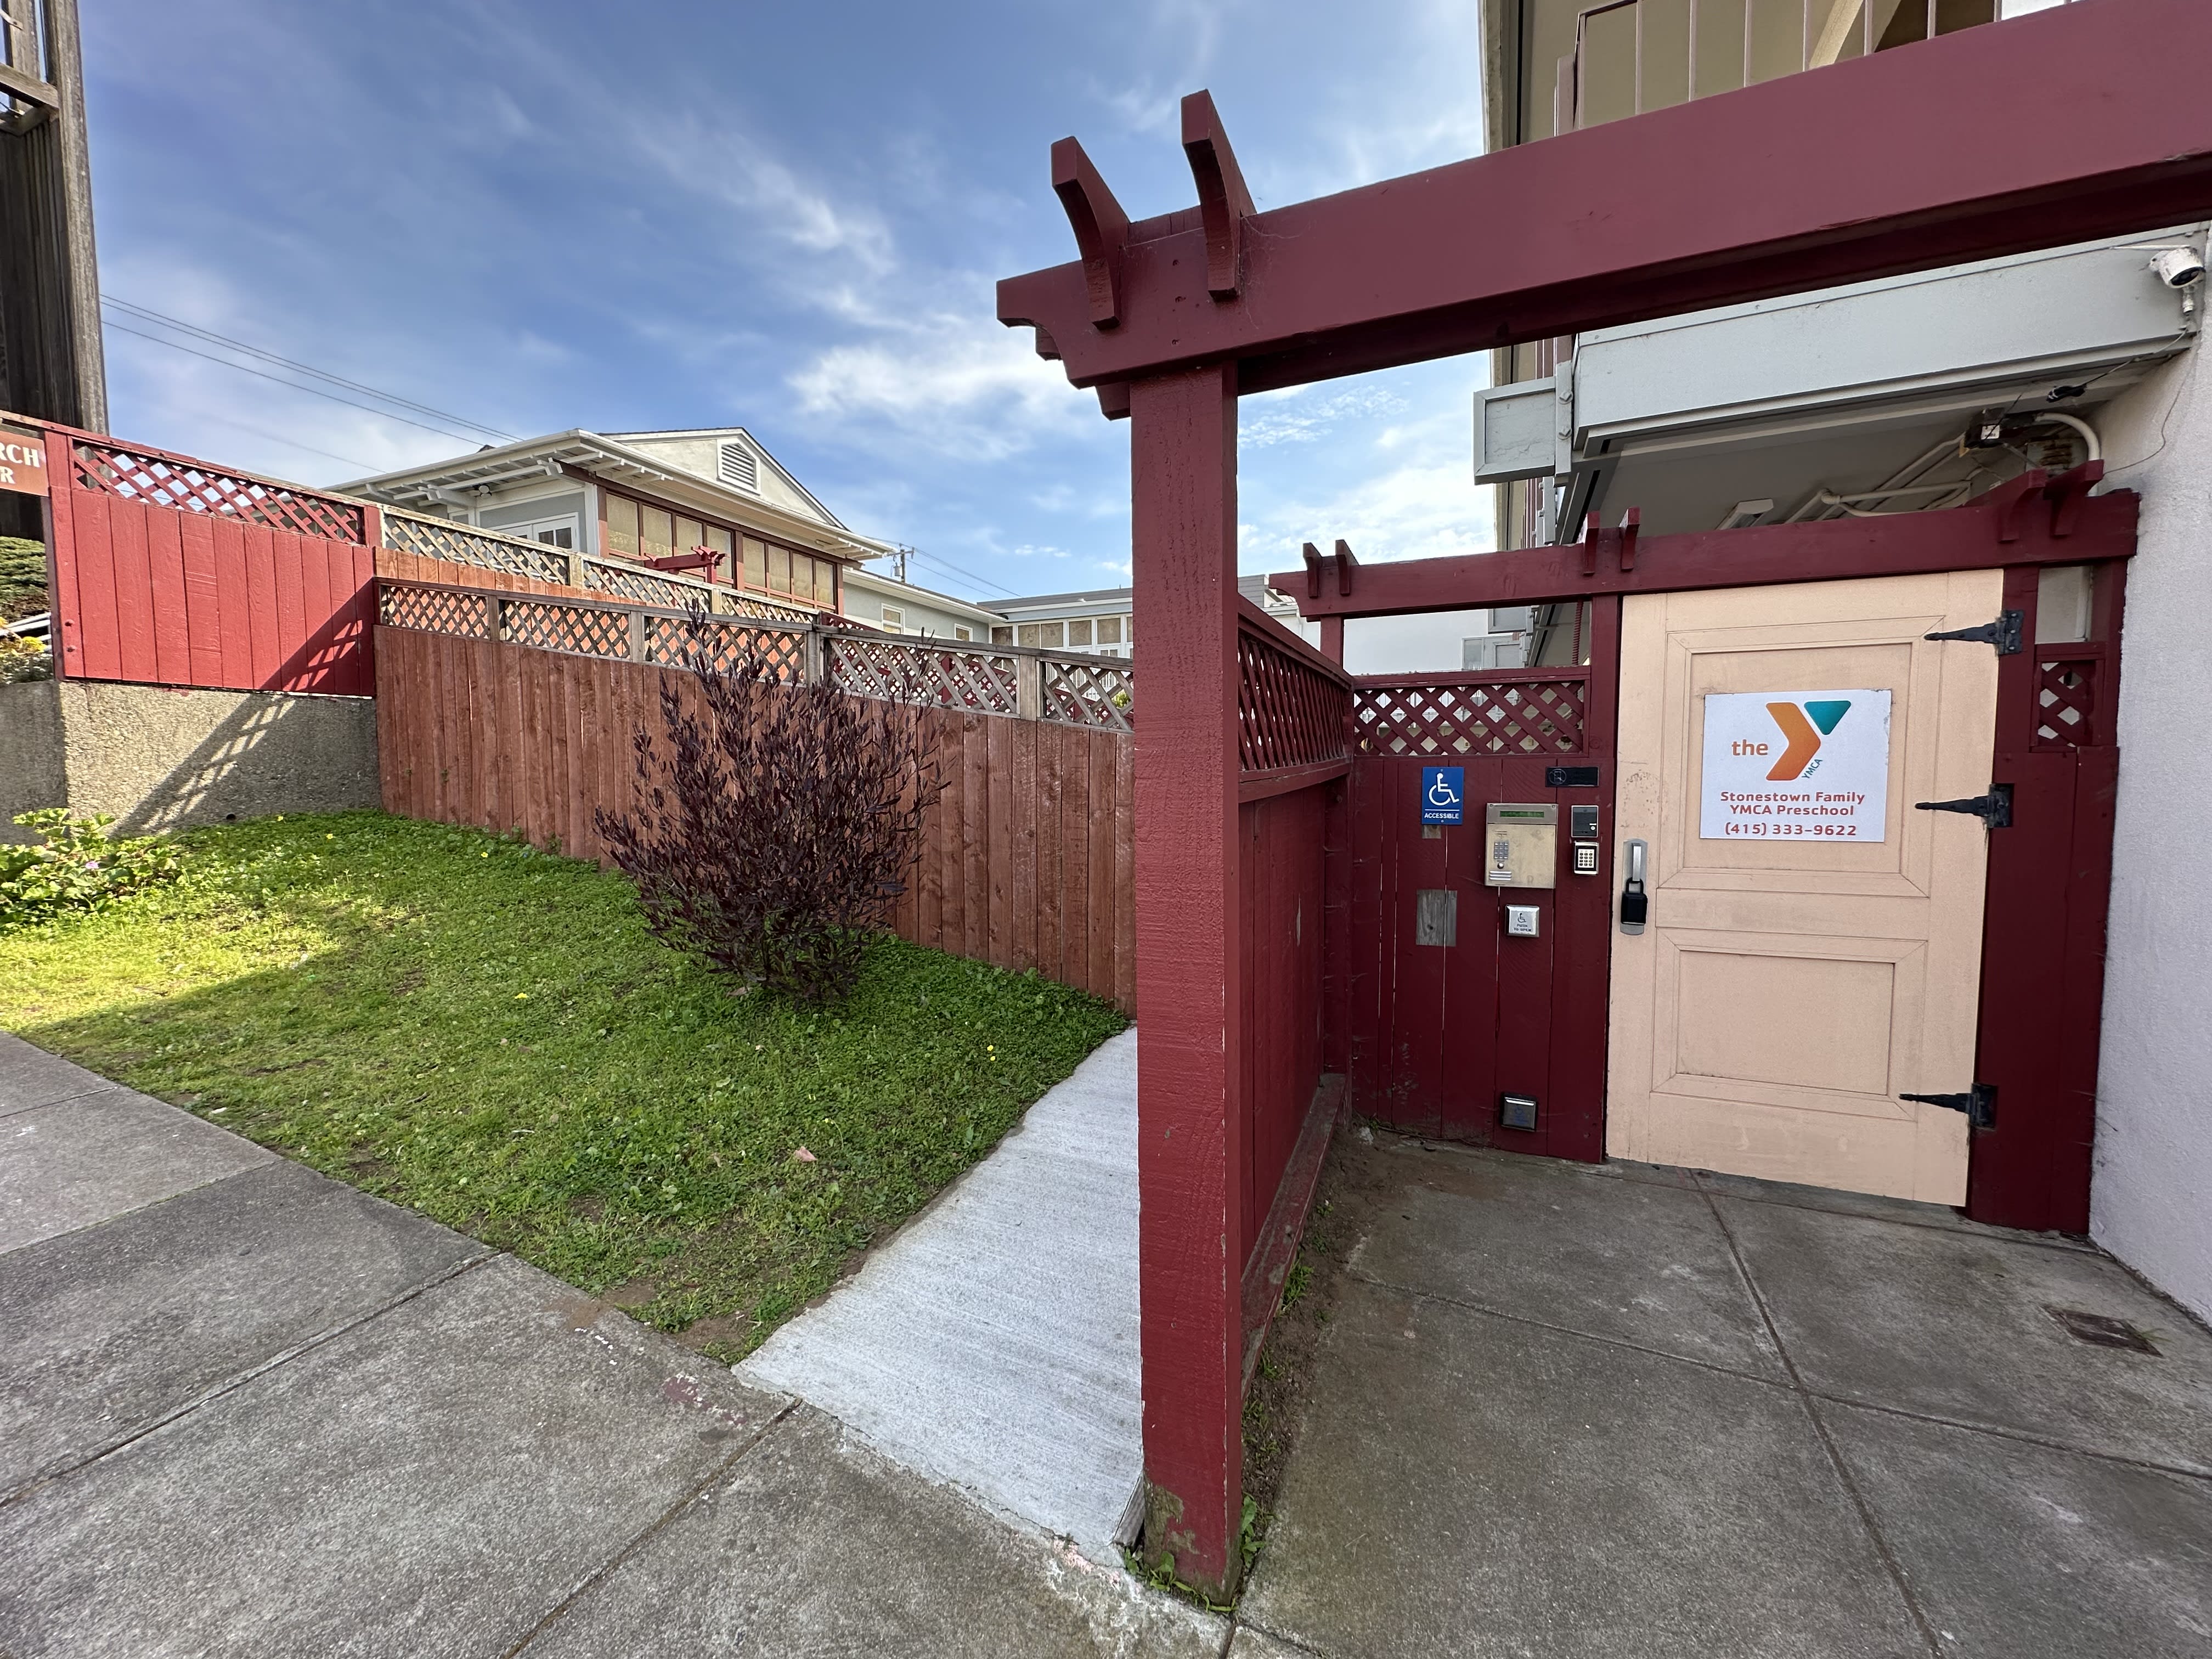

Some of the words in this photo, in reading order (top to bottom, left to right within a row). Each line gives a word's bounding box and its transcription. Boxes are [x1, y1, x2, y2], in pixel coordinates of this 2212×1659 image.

[1731, 739, 1768, 756] the
[1801, 758, 1823, 779] YMCA
[1720, 791, 1810, 802] Stonestown
[1815, 791, 1865, 805] Family
[1730, 805, 1772, 815] YMCA
[1777, 805, 1854, 816] Preschool
[1725, 822, 1767, 836] (415)
[1773, 824, 1857, 836] 333-9622
